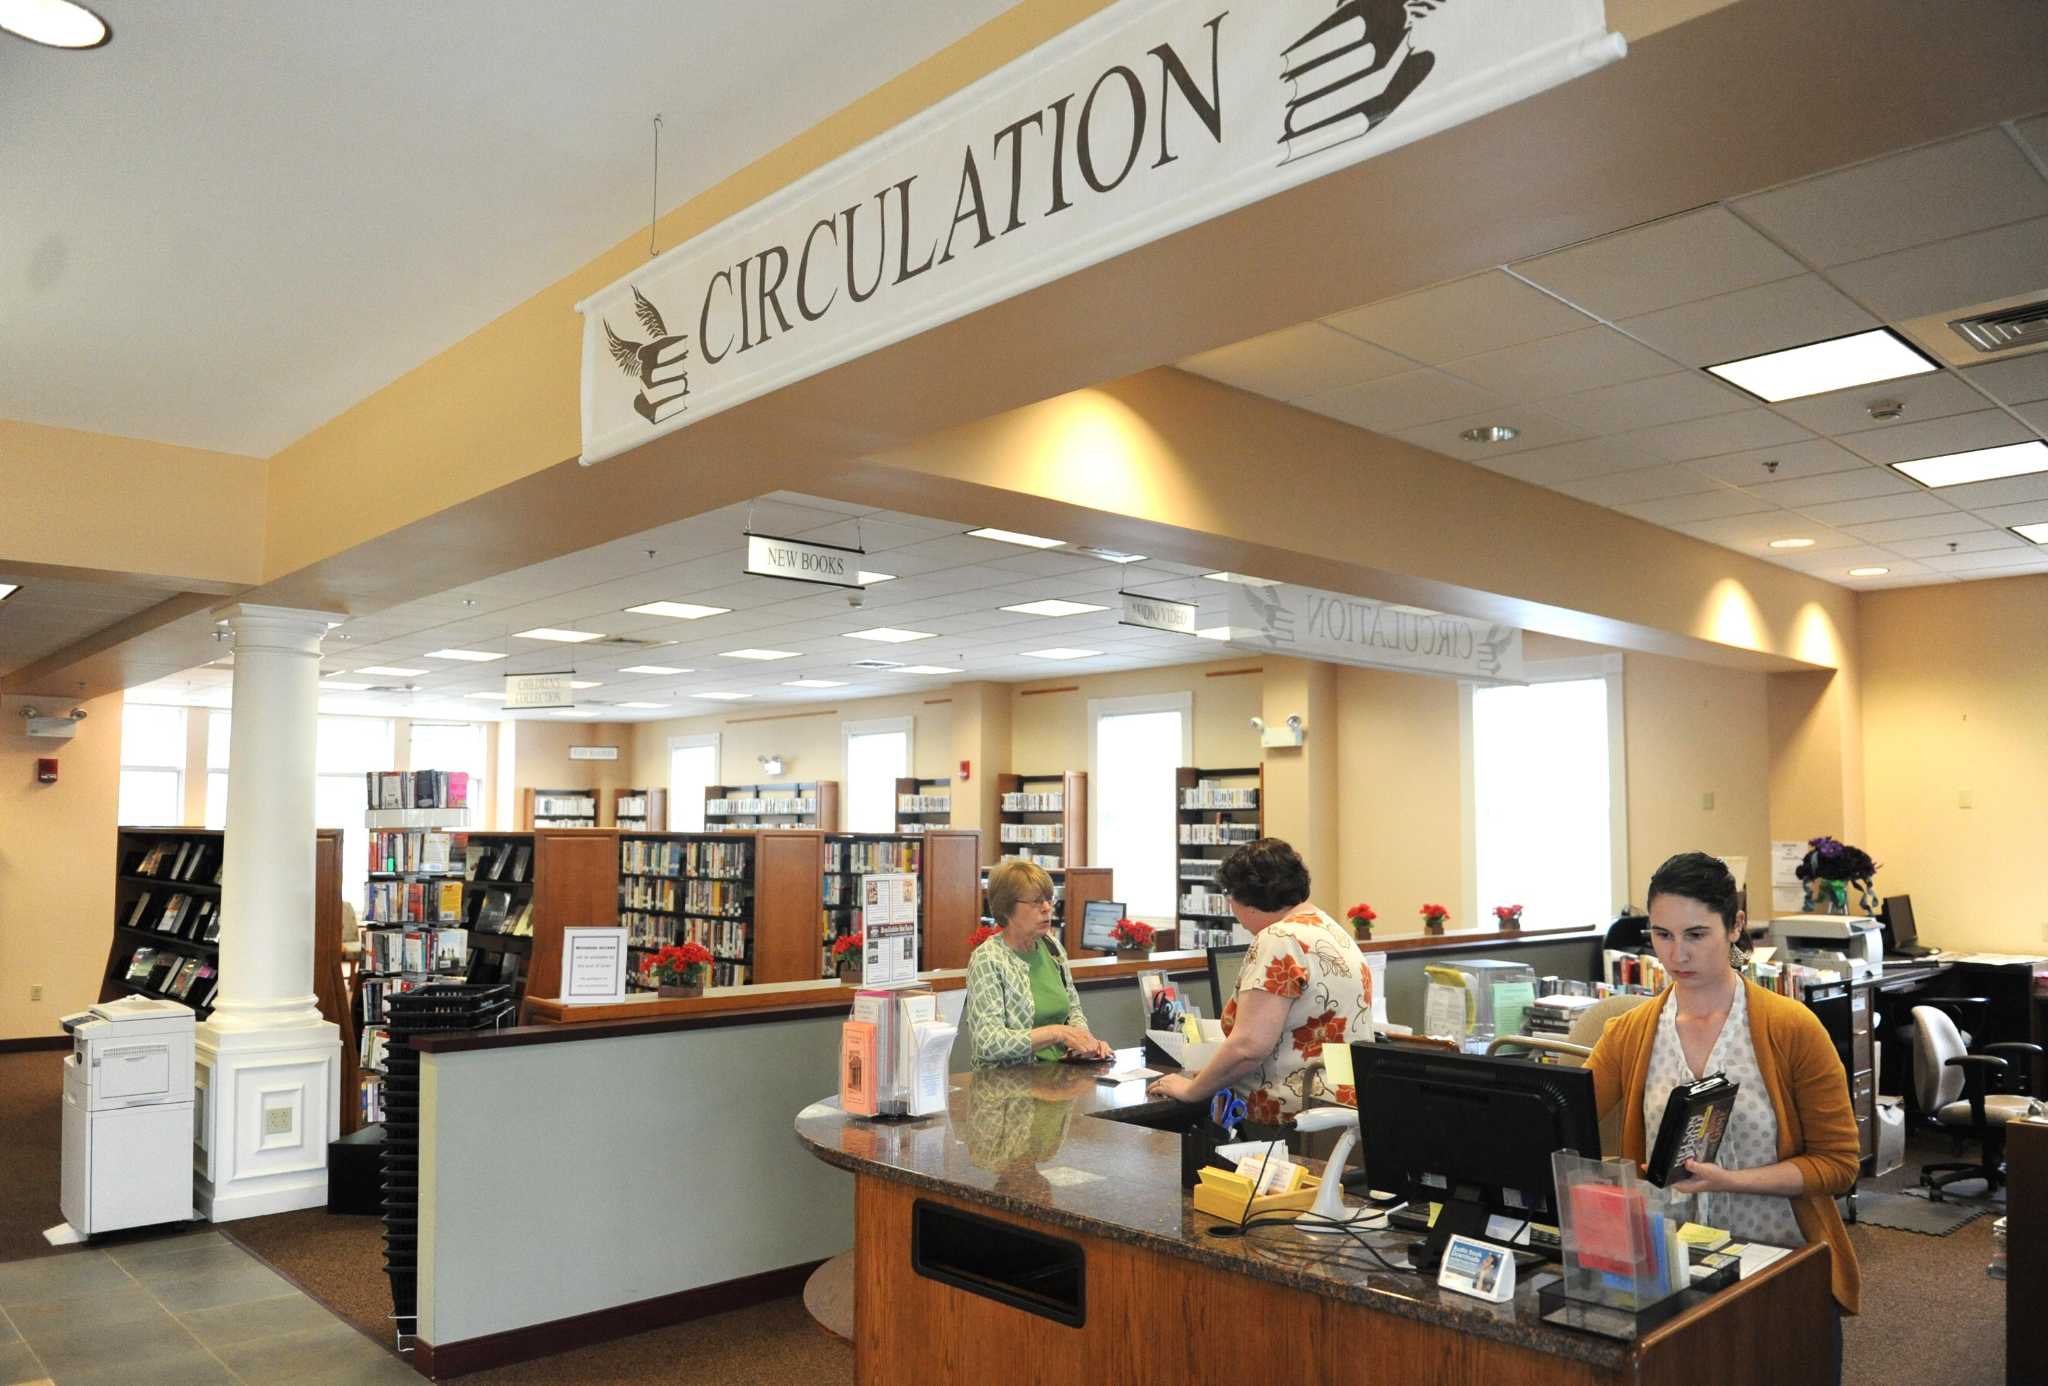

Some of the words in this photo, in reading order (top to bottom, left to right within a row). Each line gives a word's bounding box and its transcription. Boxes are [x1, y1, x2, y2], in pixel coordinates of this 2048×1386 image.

[699, 11, 1230, 366] CIRCULATION
[768, 547, 797, 567] NEW
[801, 552, 844, 574] BOOKS
